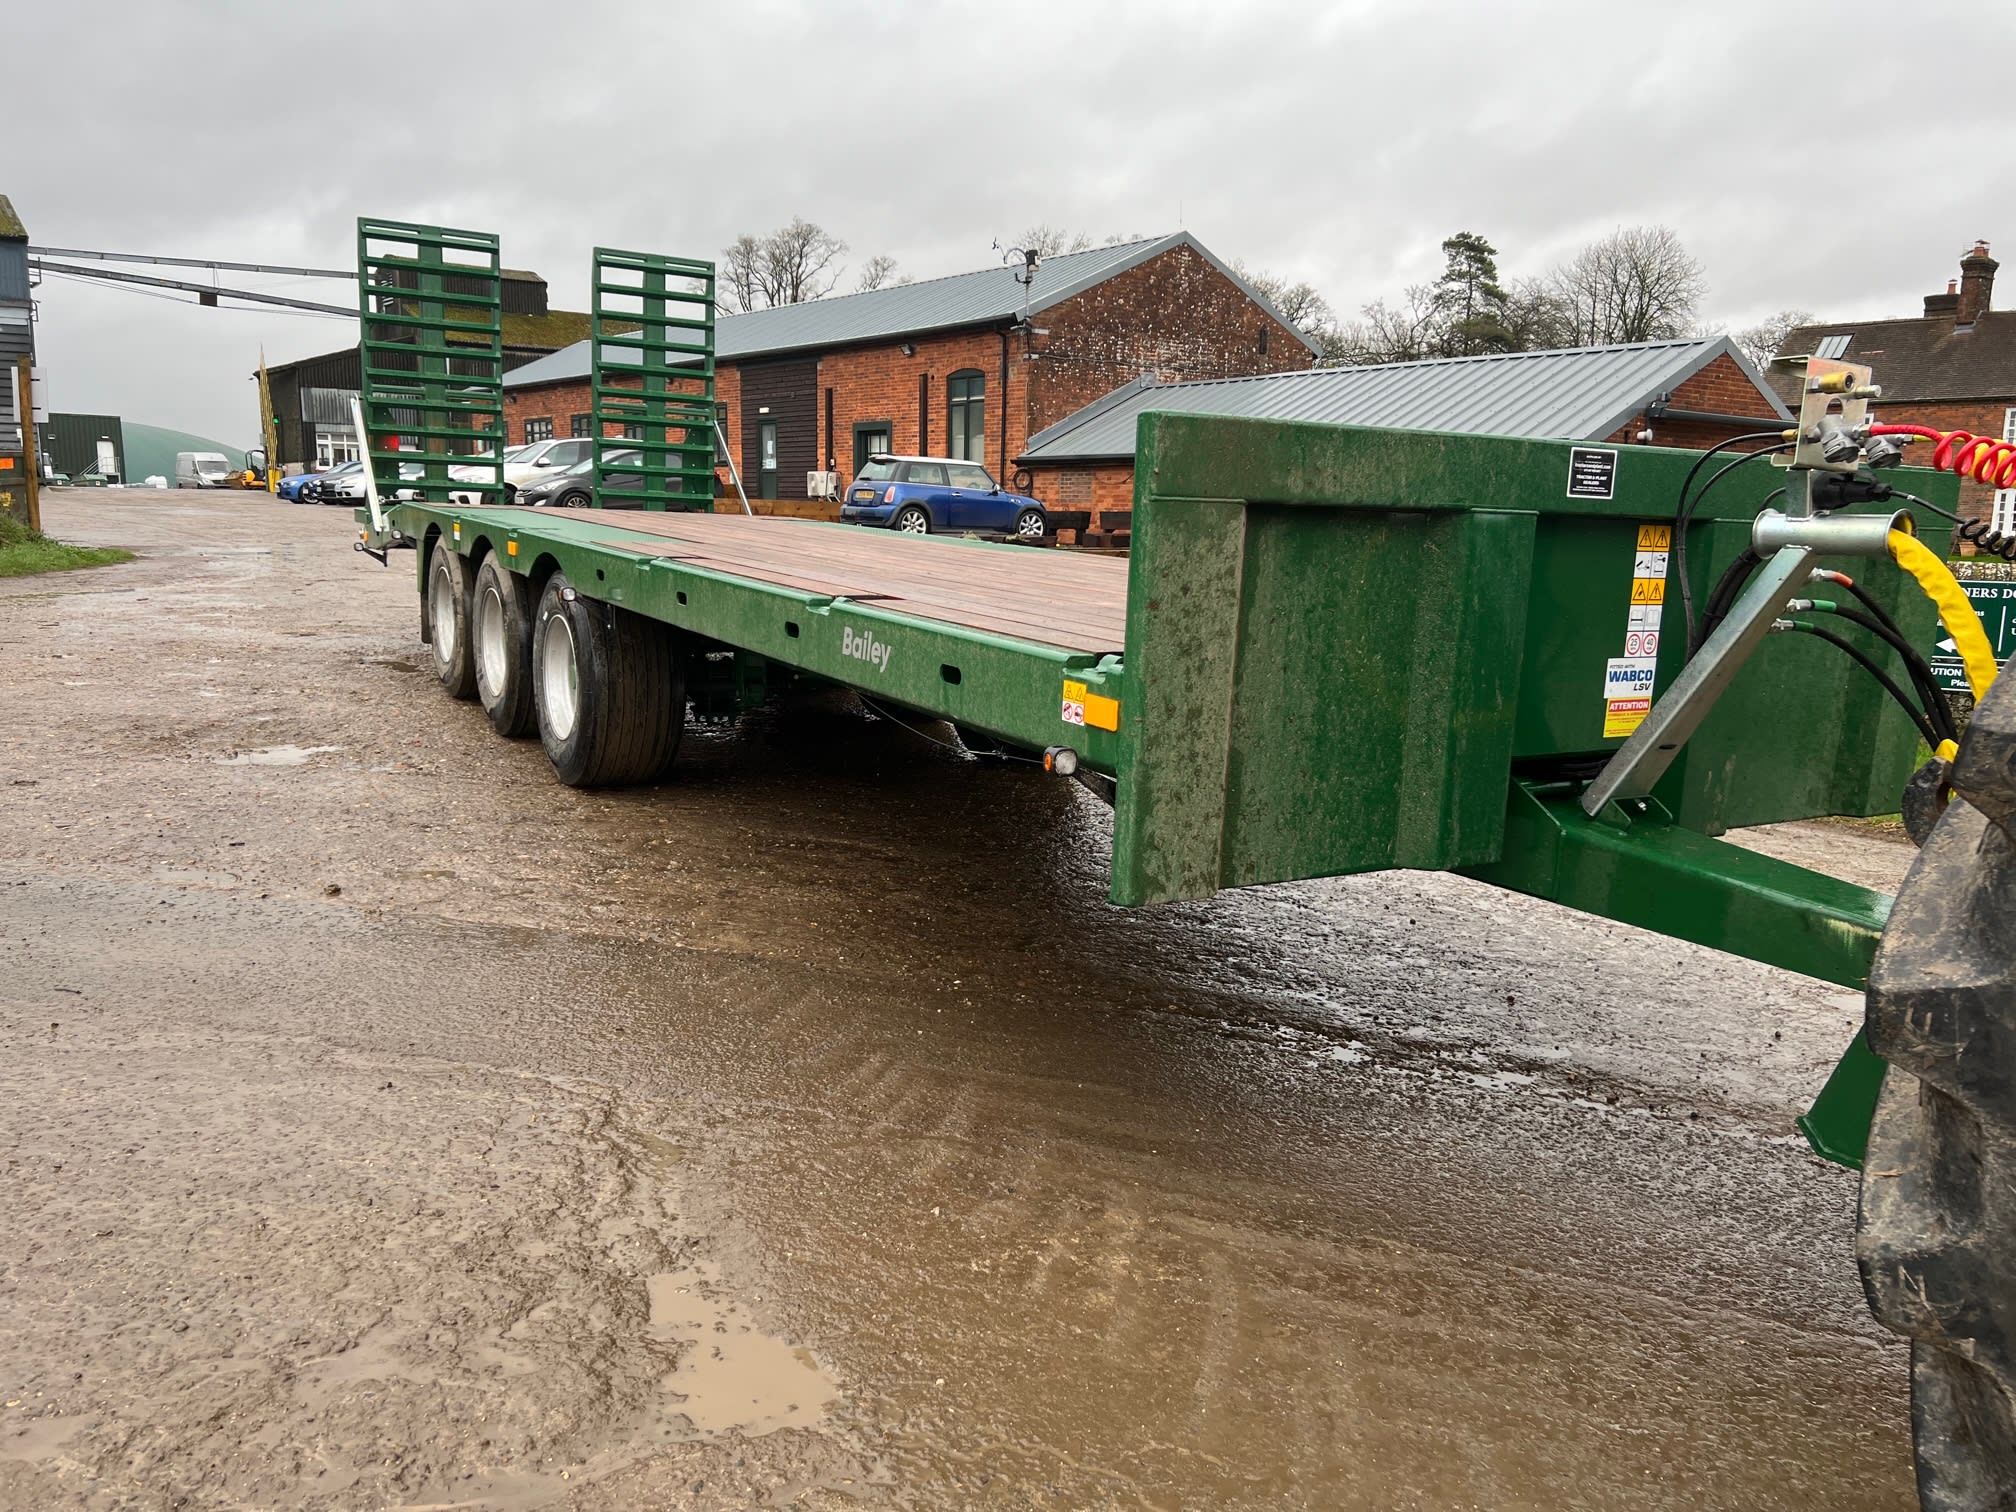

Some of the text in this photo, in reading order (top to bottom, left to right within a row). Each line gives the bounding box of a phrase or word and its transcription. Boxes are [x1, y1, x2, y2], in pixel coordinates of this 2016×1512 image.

[842, 626, 892, 673] Bailey
[1608, 670, 1653, 682] WABCO
[1633, 683, 1651, 691] LSV
[1609, 701, 1649, 711] ATTENTION
